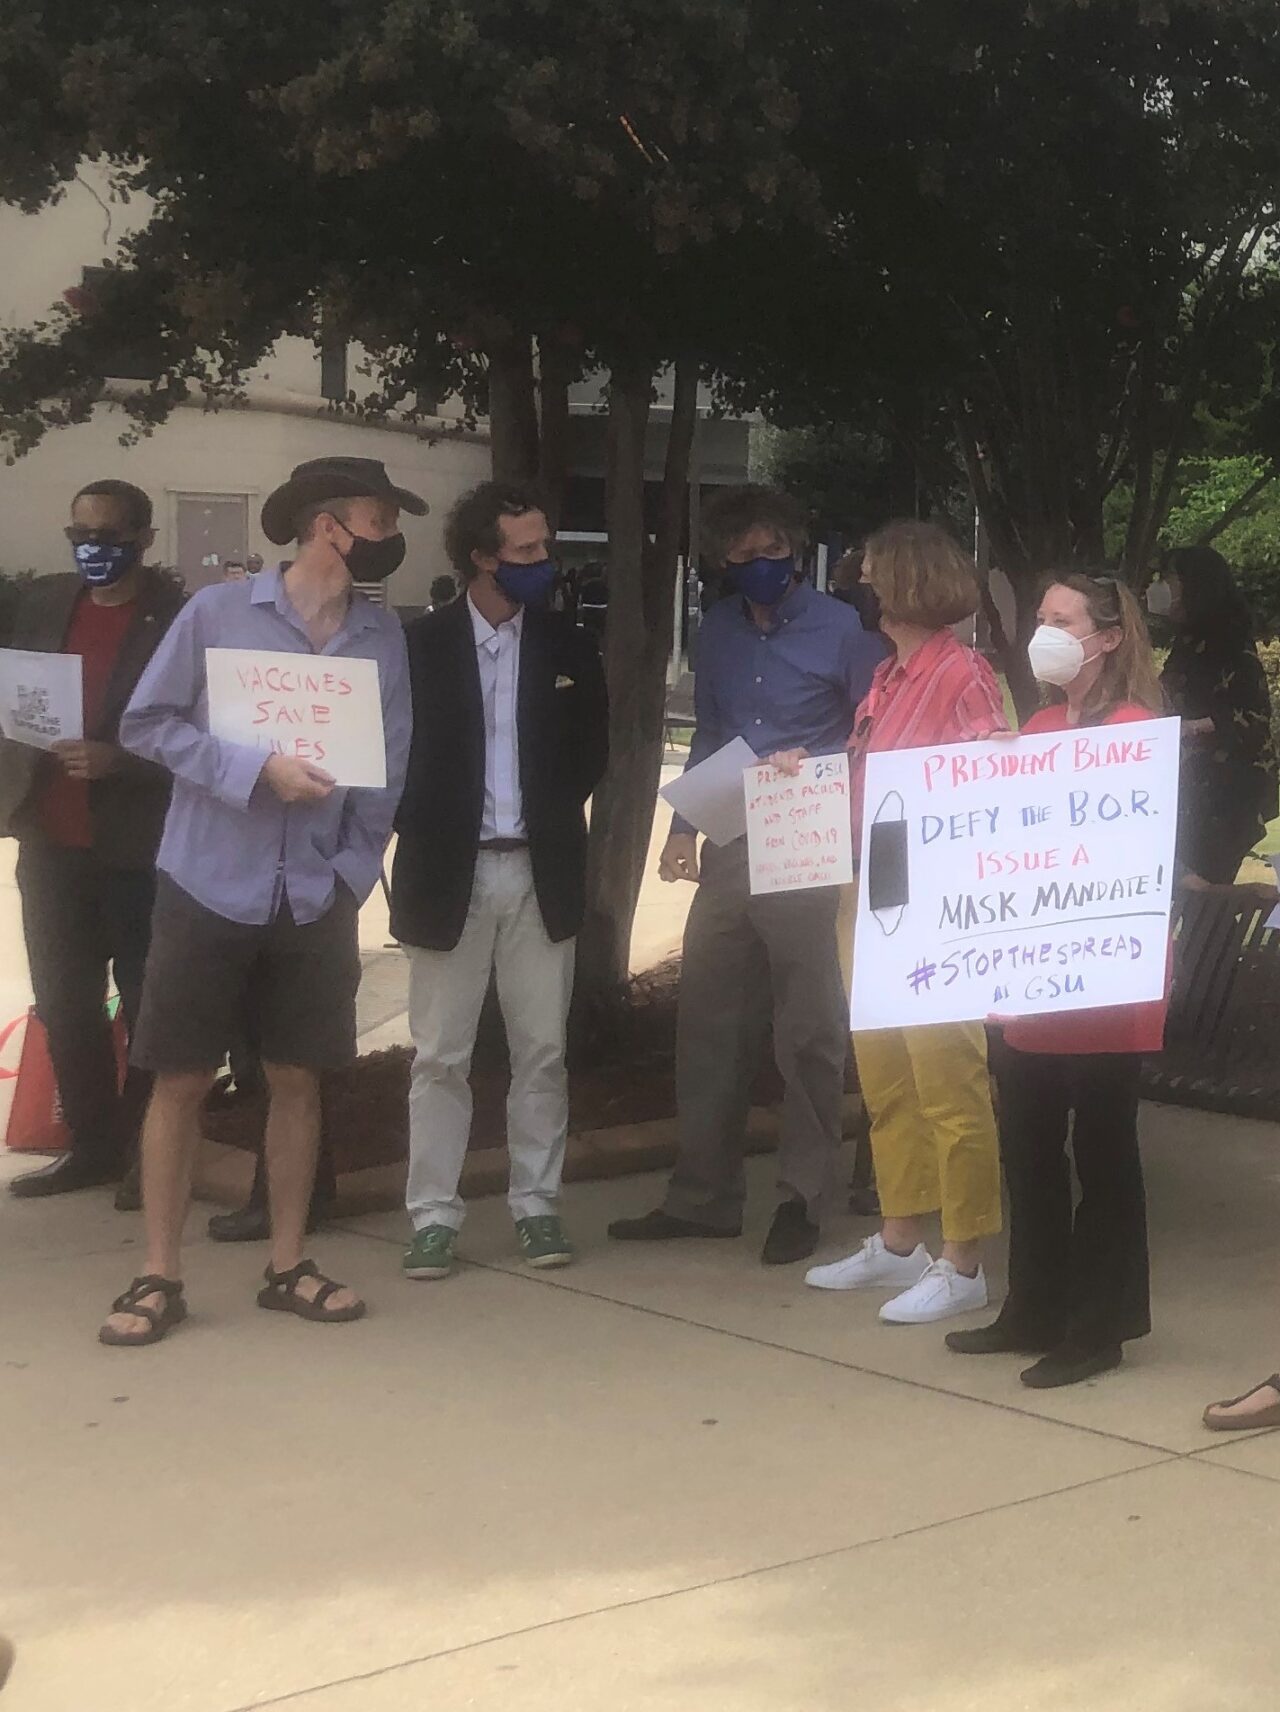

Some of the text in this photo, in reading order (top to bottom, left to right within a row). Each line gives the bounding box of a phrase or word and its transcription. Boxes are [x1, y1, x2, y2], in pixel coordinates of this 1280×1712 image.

[237, 667, 353, 695] VACCINES
[252, 700, 331, 724] SAVE
[814, 762, 843, 779] GSU
[923, 737, 1159, 792] PRESIDENT BLAKE
[788, 803, 822, 824] STAFF
[921, 789, 1160, 845] DEFY THE B.O.R.
[976, 843, 1090, 880] ISSUE A
[938, 864, 1164, 930] MASK MANDATE!
[906, 934, 1143, 996] #STOPTHESPREAD
[1024, 974, 1085, 1001] GSU
